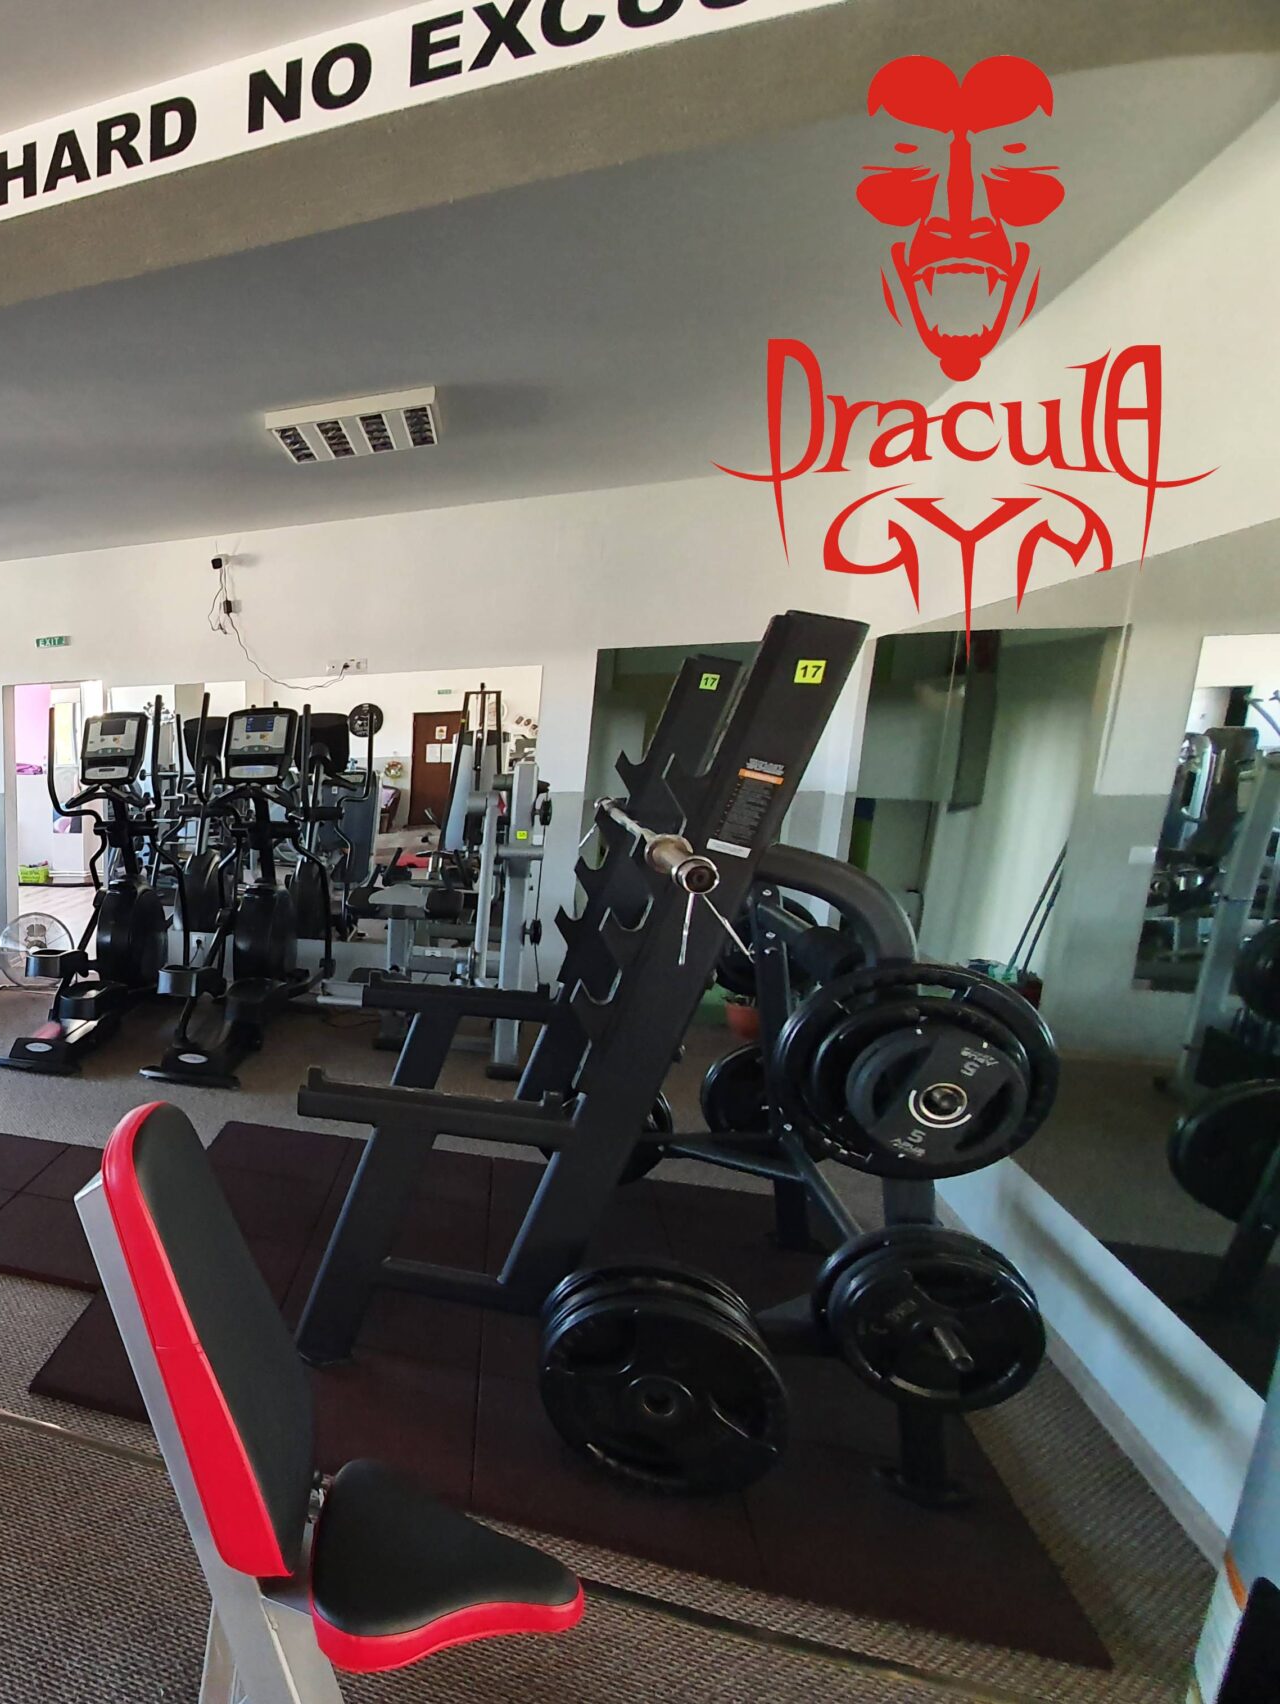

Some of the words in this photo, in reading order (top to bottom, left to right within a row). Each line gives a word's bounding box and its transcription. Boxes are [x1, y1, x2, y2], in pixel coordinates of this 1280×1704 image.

[248, 41, 373, 133] NO
[39, 637, 59, 647] EXIT
[800, 664, 823, 678] 17
[704, 677, 717, 687] 17
[960, 1060, 981, 1077] 5
[907, 1128, 926, 1143] 5
